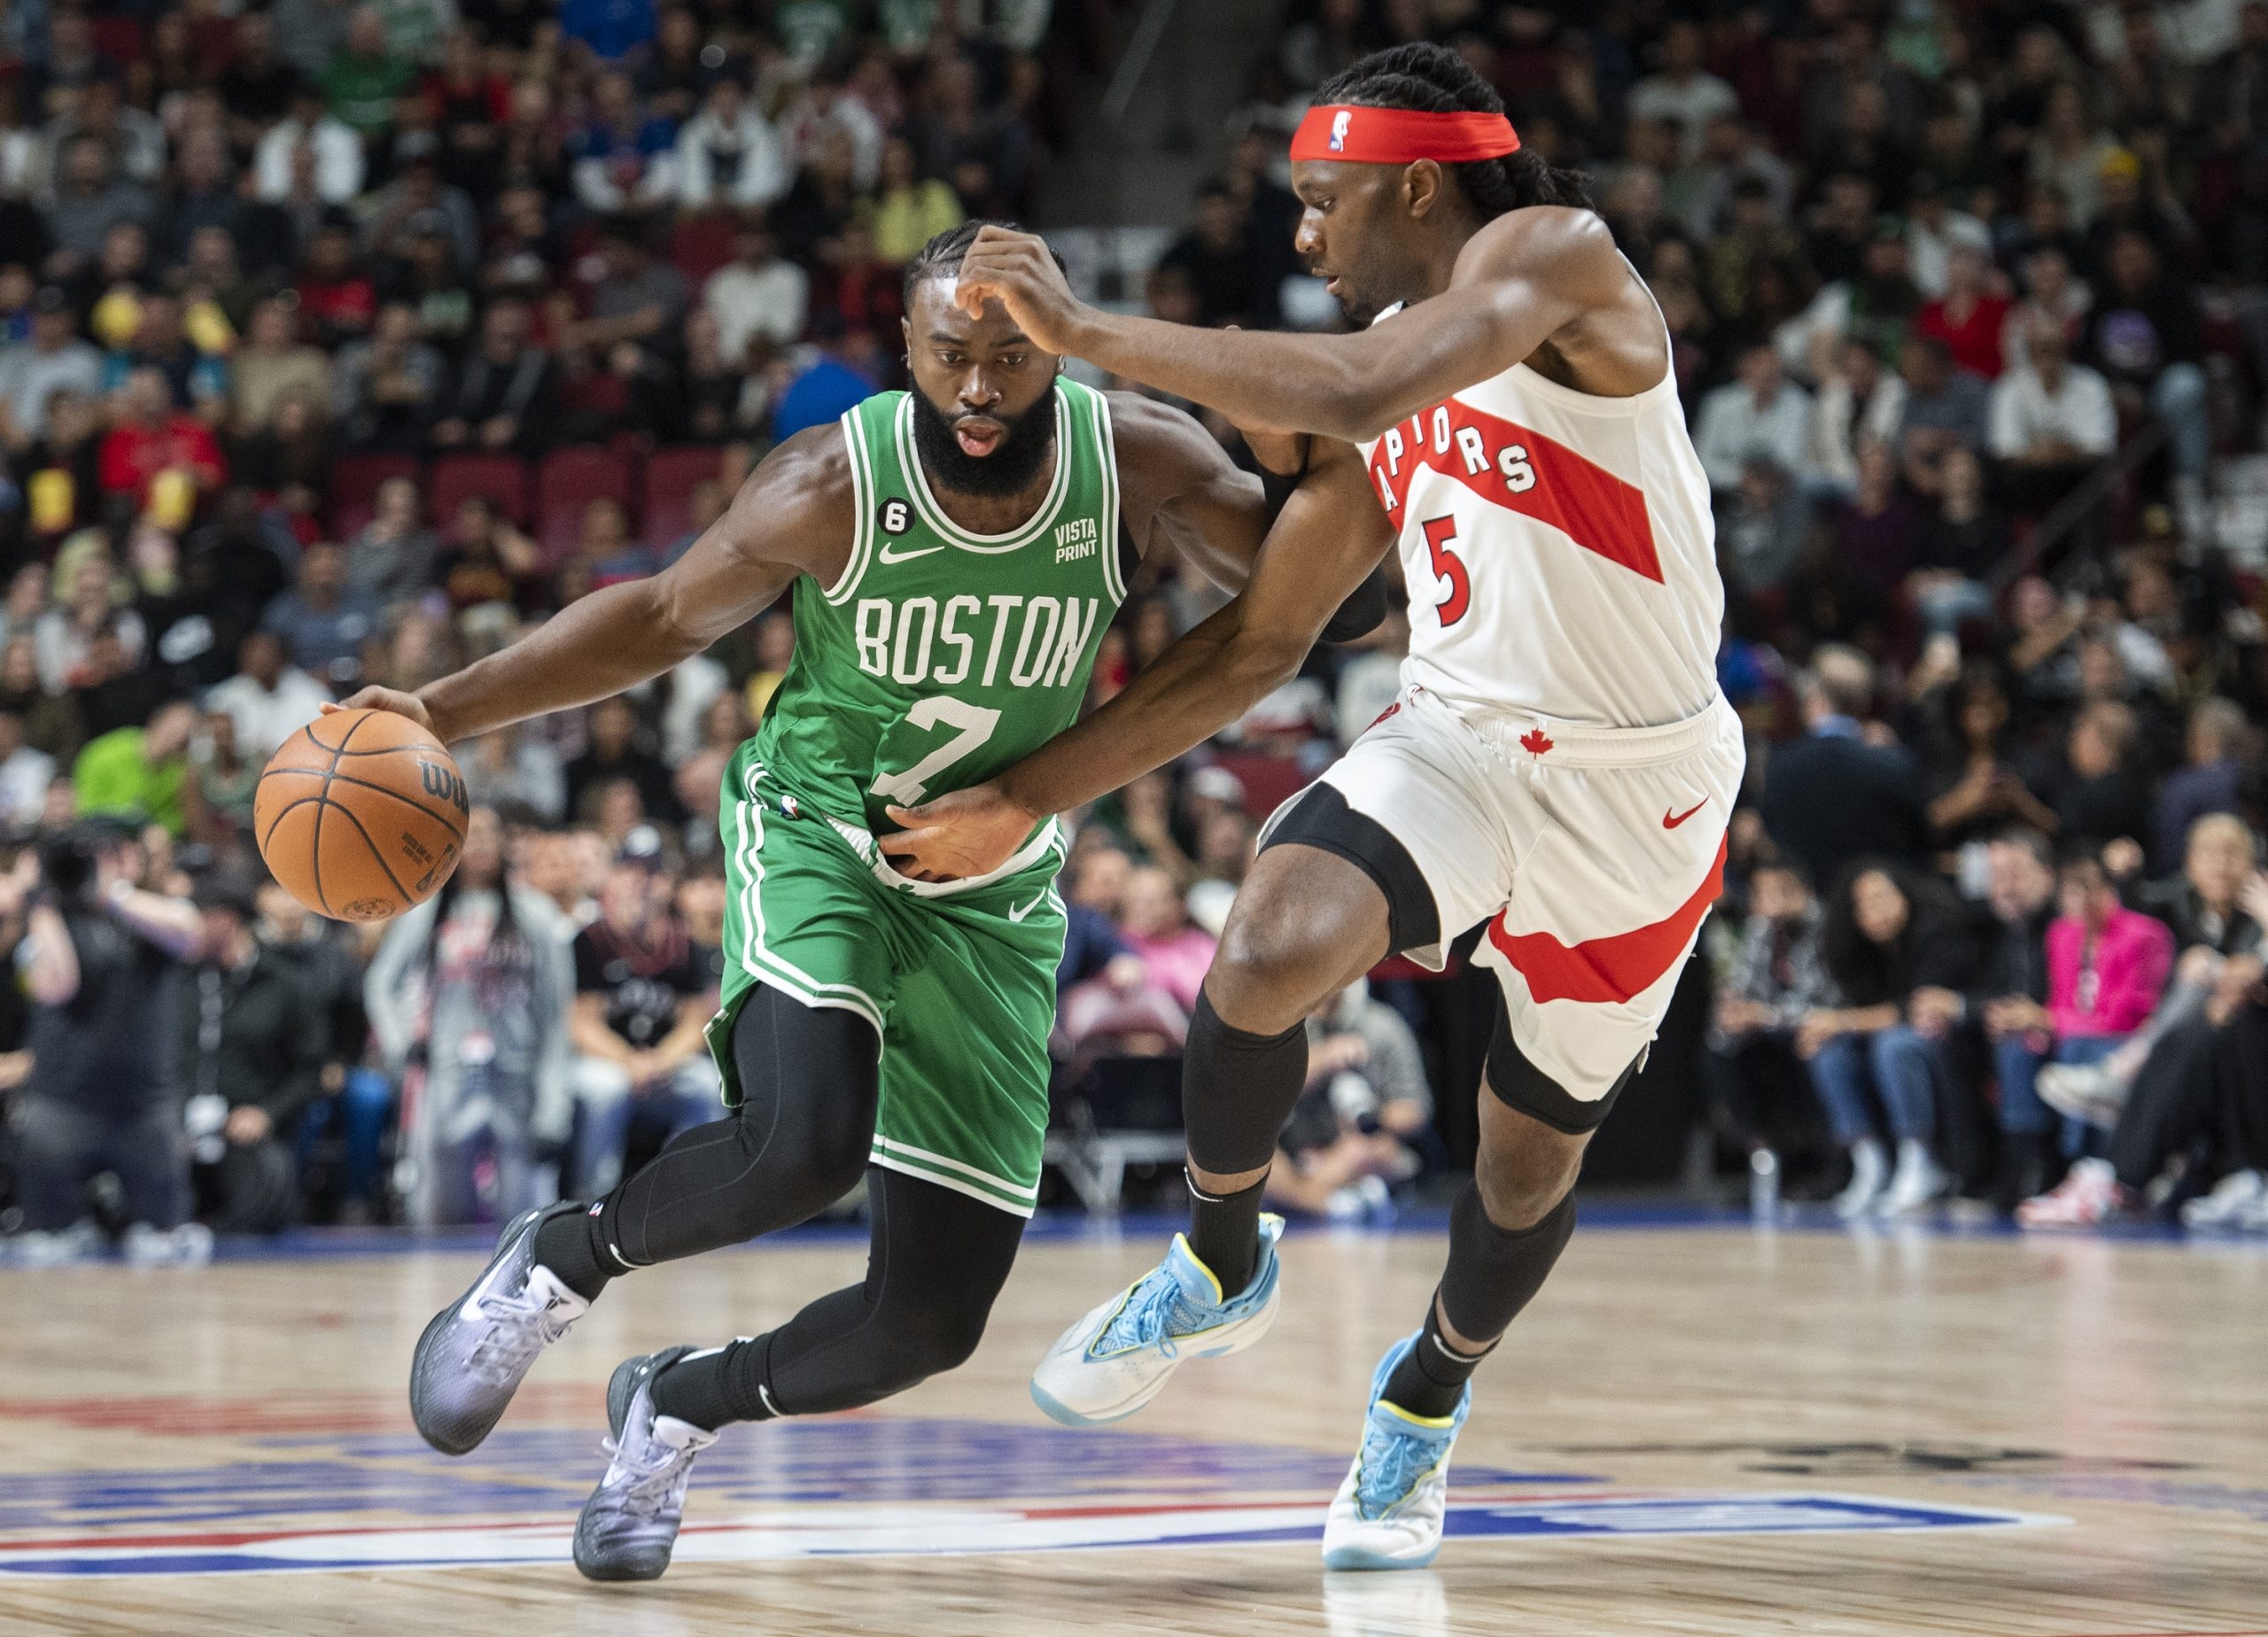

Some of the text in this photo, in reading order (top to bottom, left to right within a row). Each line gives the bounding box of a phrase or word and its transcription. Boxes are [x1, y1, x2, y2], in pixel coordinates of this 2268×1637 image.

[1375, 404, 1538, 513] APORS
[885, 501, 908, 531] 6
[1054, 517, 1098, 548] VISTA
[1055, 539, 1098, 564] PRINT
[1421, 513, 1472, 629] 5
[855, 594, 1099, 688] BOSTON
[869, 694, 1003, 808] 7
